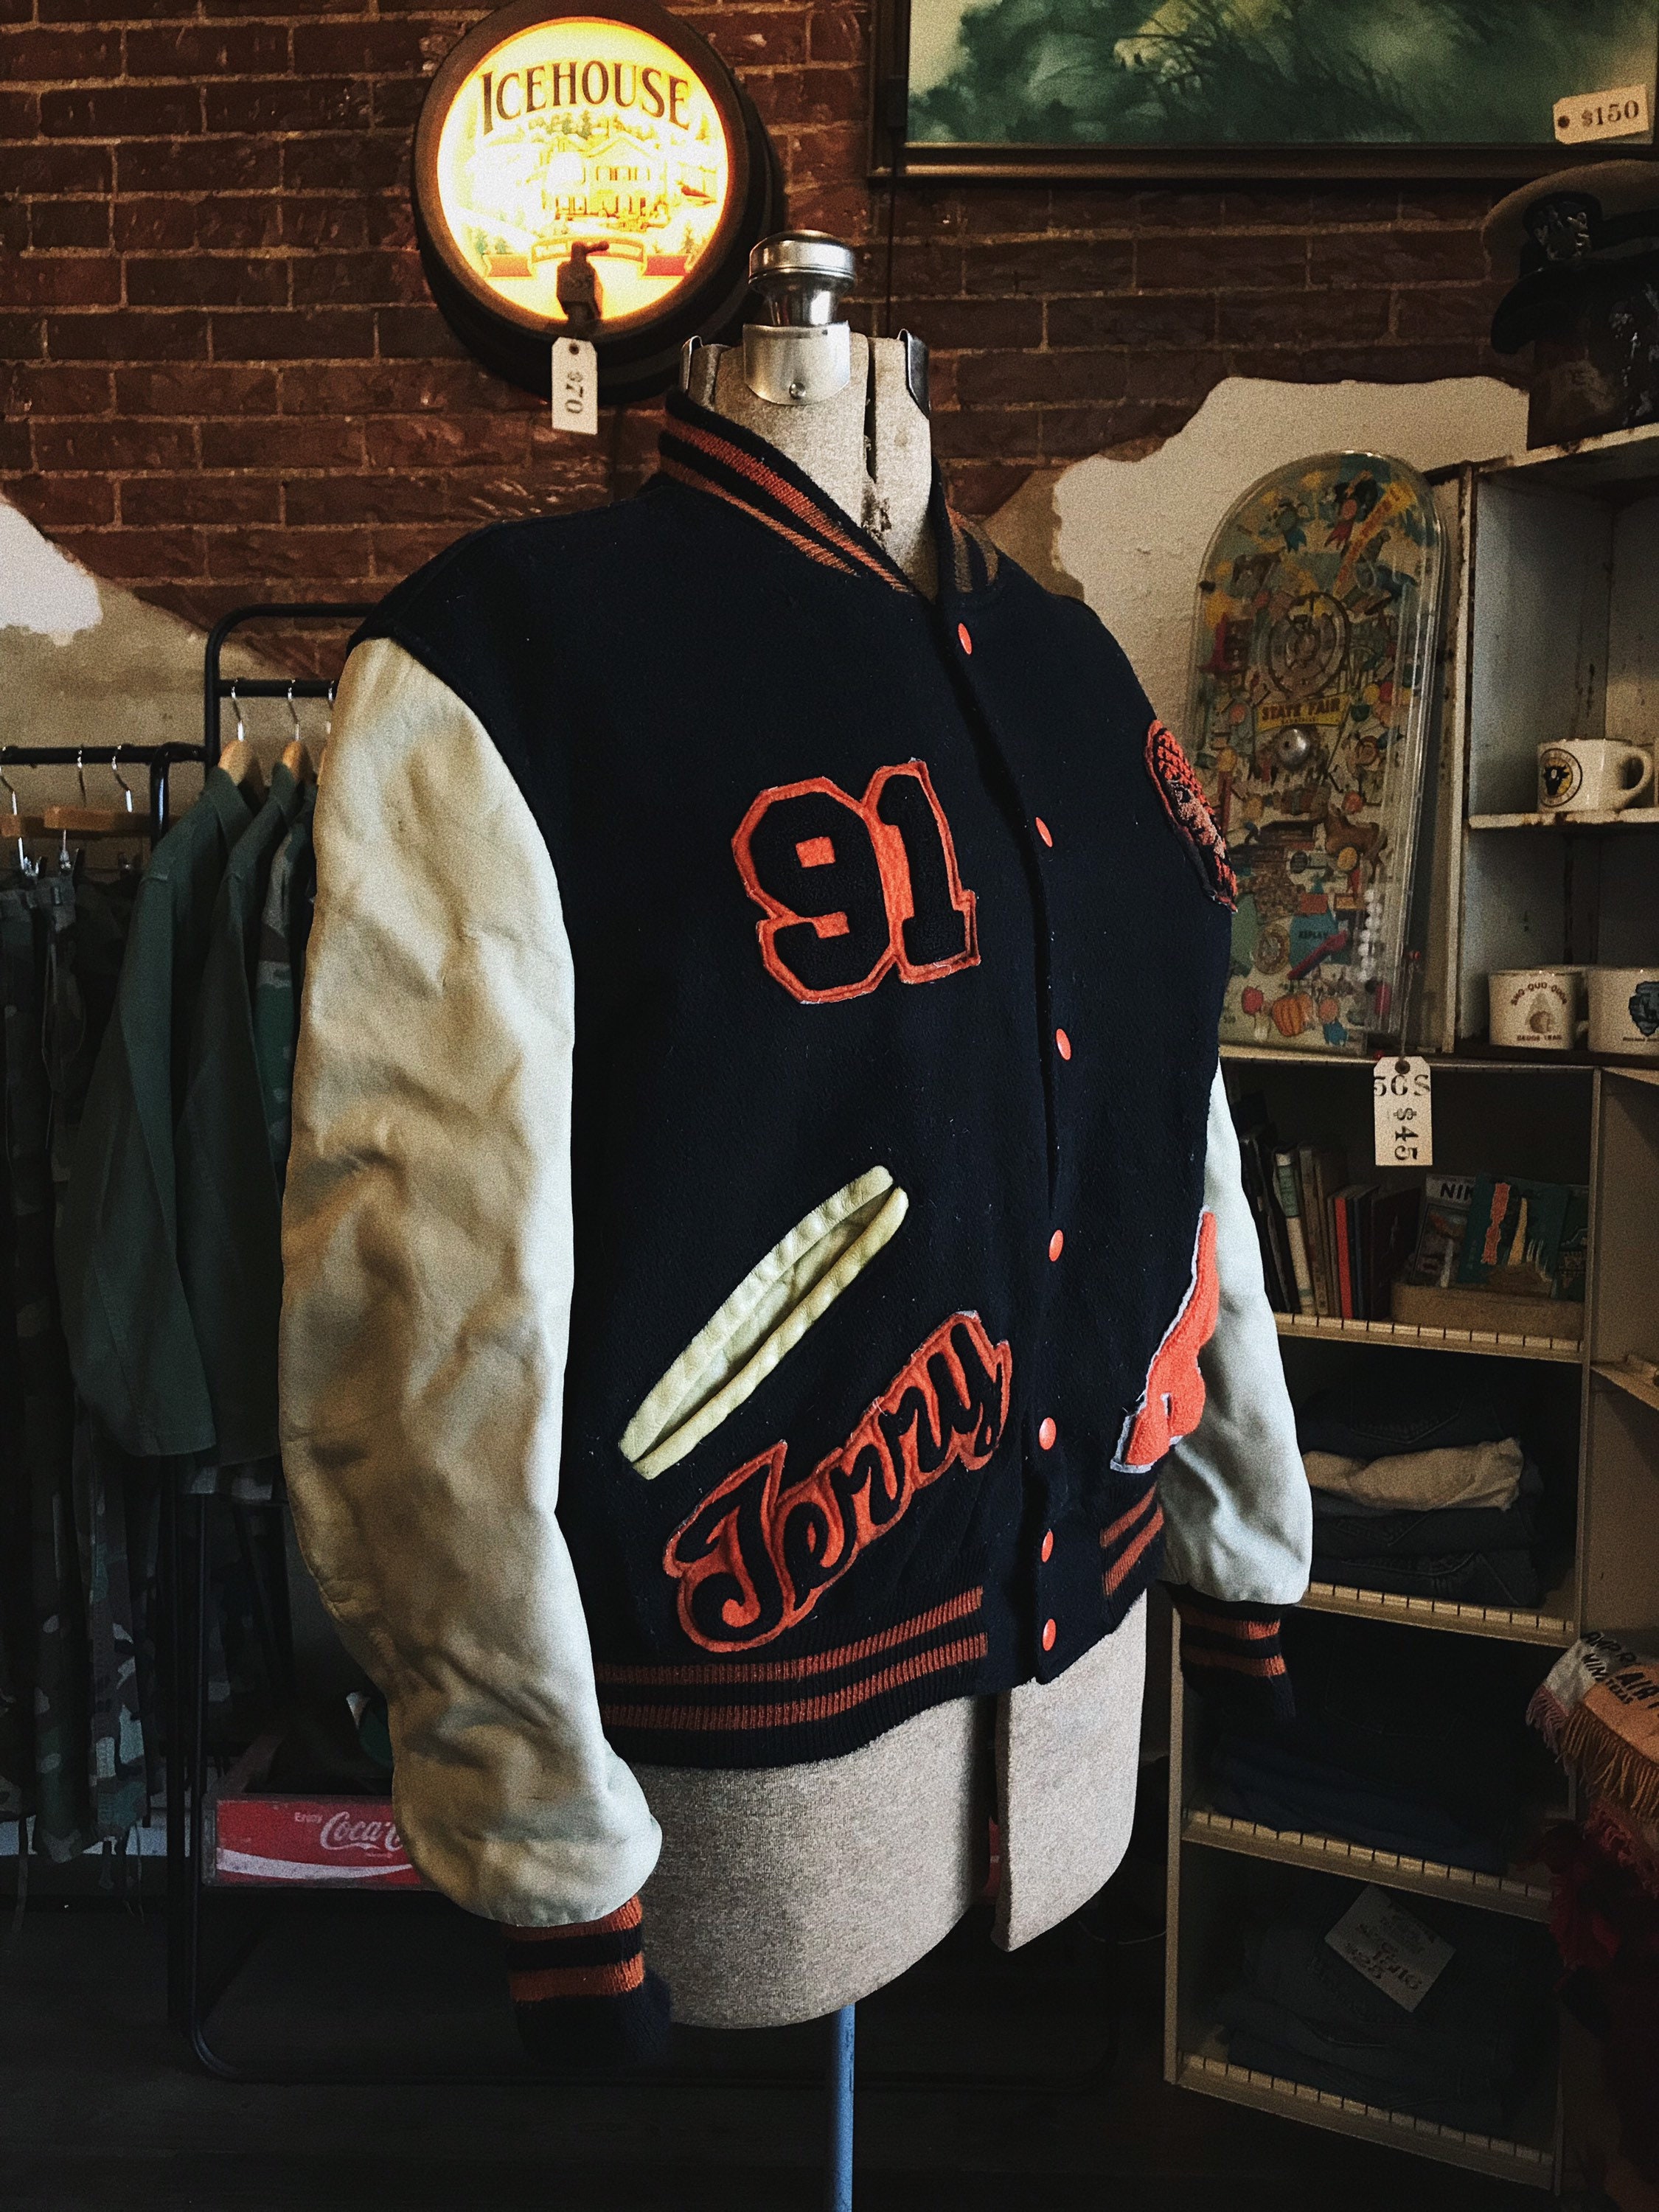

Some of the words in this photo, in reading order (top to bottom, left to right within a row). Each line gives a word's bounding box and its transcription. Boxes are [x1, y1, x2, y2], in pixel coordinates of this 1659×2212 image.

[478, 60, 691, 136] ICEHOUSE
[1581, 100, 1640, 128] $150
[731, 757, 981, 1004] 91
[1393, 1107, 1419, 1161] $45
[1605, 1678, 1634, 1705] TEXAS
[293, 1811, 324, 1824] Enjoy
